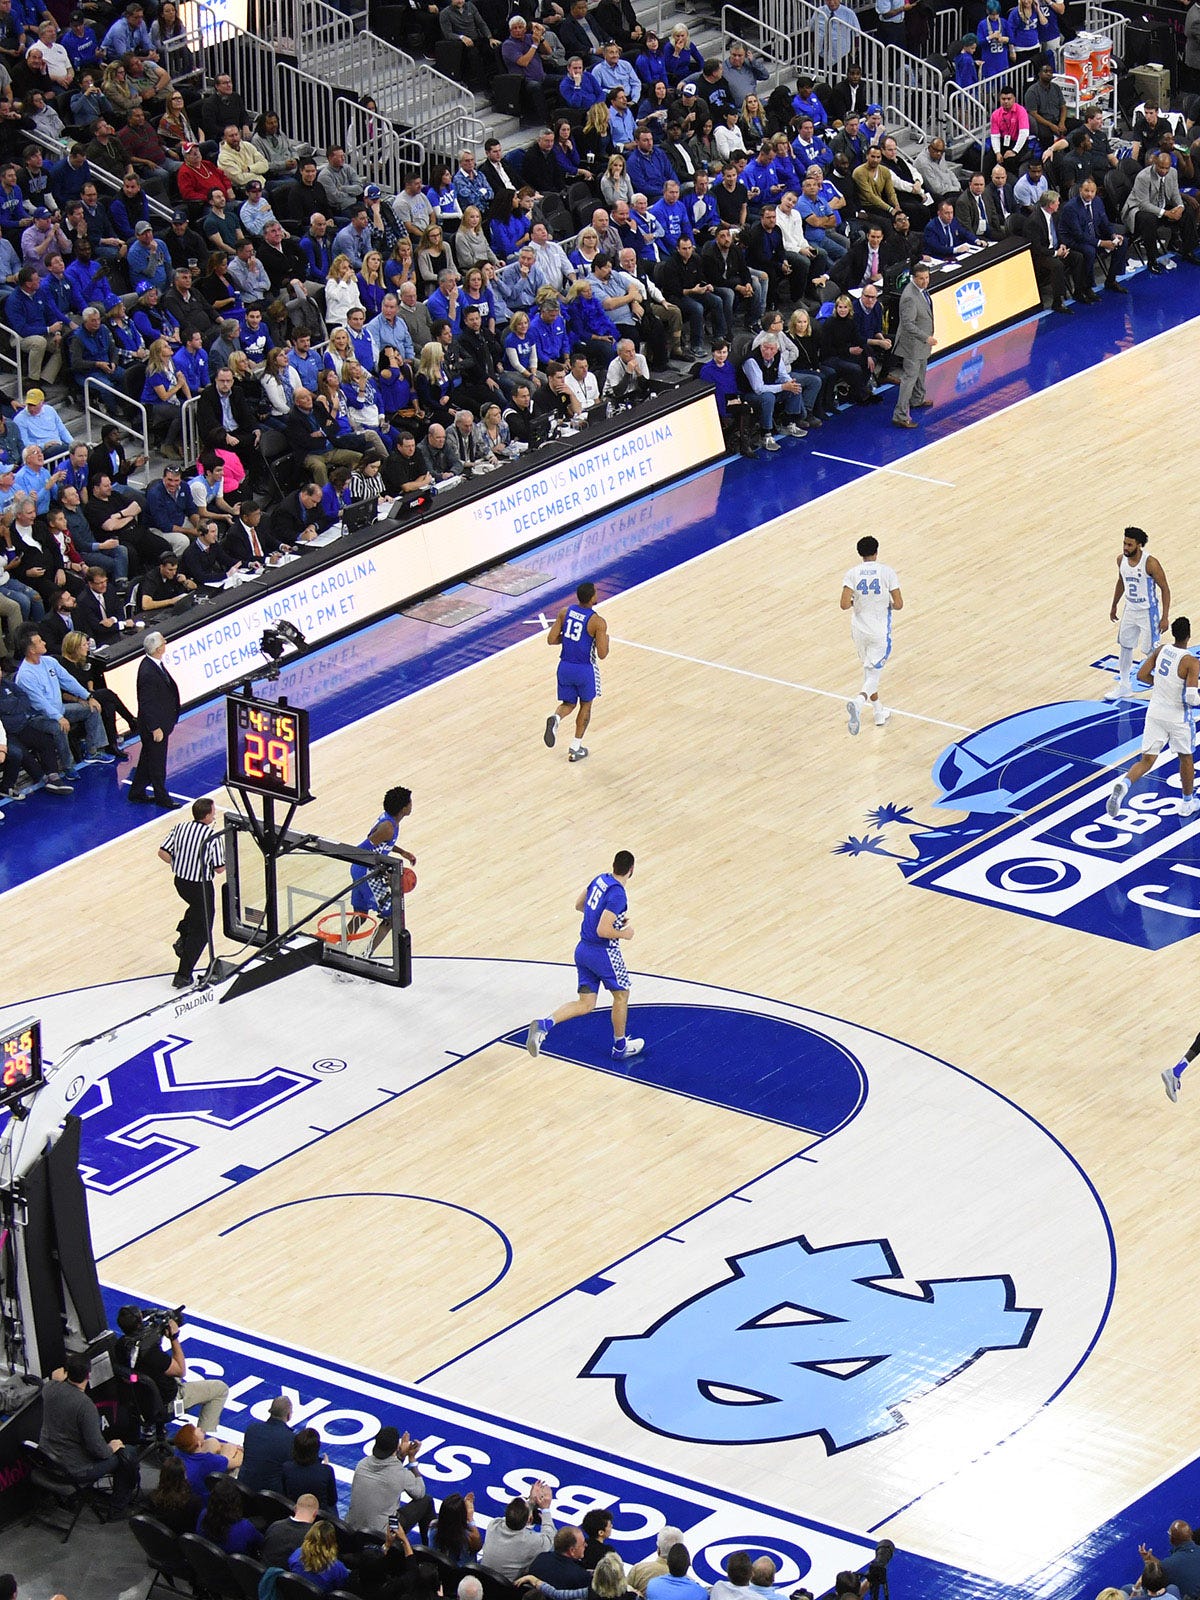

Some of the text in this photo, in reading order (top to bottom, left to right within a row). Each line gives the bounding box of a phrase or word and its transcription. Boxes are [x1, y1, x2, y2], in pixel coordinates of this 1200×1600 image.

[485, 480, 549, 520] STANFORD
[551, 472, 567, 490] VS
[569, 452, 610, 480] NORTH
[613, 425, 673, 460] CAROLINA
[514, 458, 654, 534] DECEMBER 30 2 PM ET
[856, 578, 881, 595] 44
[1128, 584, 1138, 597] 2
[173, 621, 241, 666] STANFORD
[244, 611, 260, 631] VS
[263, 589, 308, 620] NORTH
[312, 560, 377, 600] CAROLINA
[203, 595, 355, 679] DECEMB 2 PM ET
[564, 618, 584, 642] 13
[1158, 658, 1172, 677] 5
[250, 710, 294, 742] 4:15
[244, 733, 290, 784] 29
[1070, 791, 1180, 849] CBS
[587, 885, 603, 911] 15
[174, 989, 214, 1019] SPALDING
[3, 1054, 30, 1087] 29
